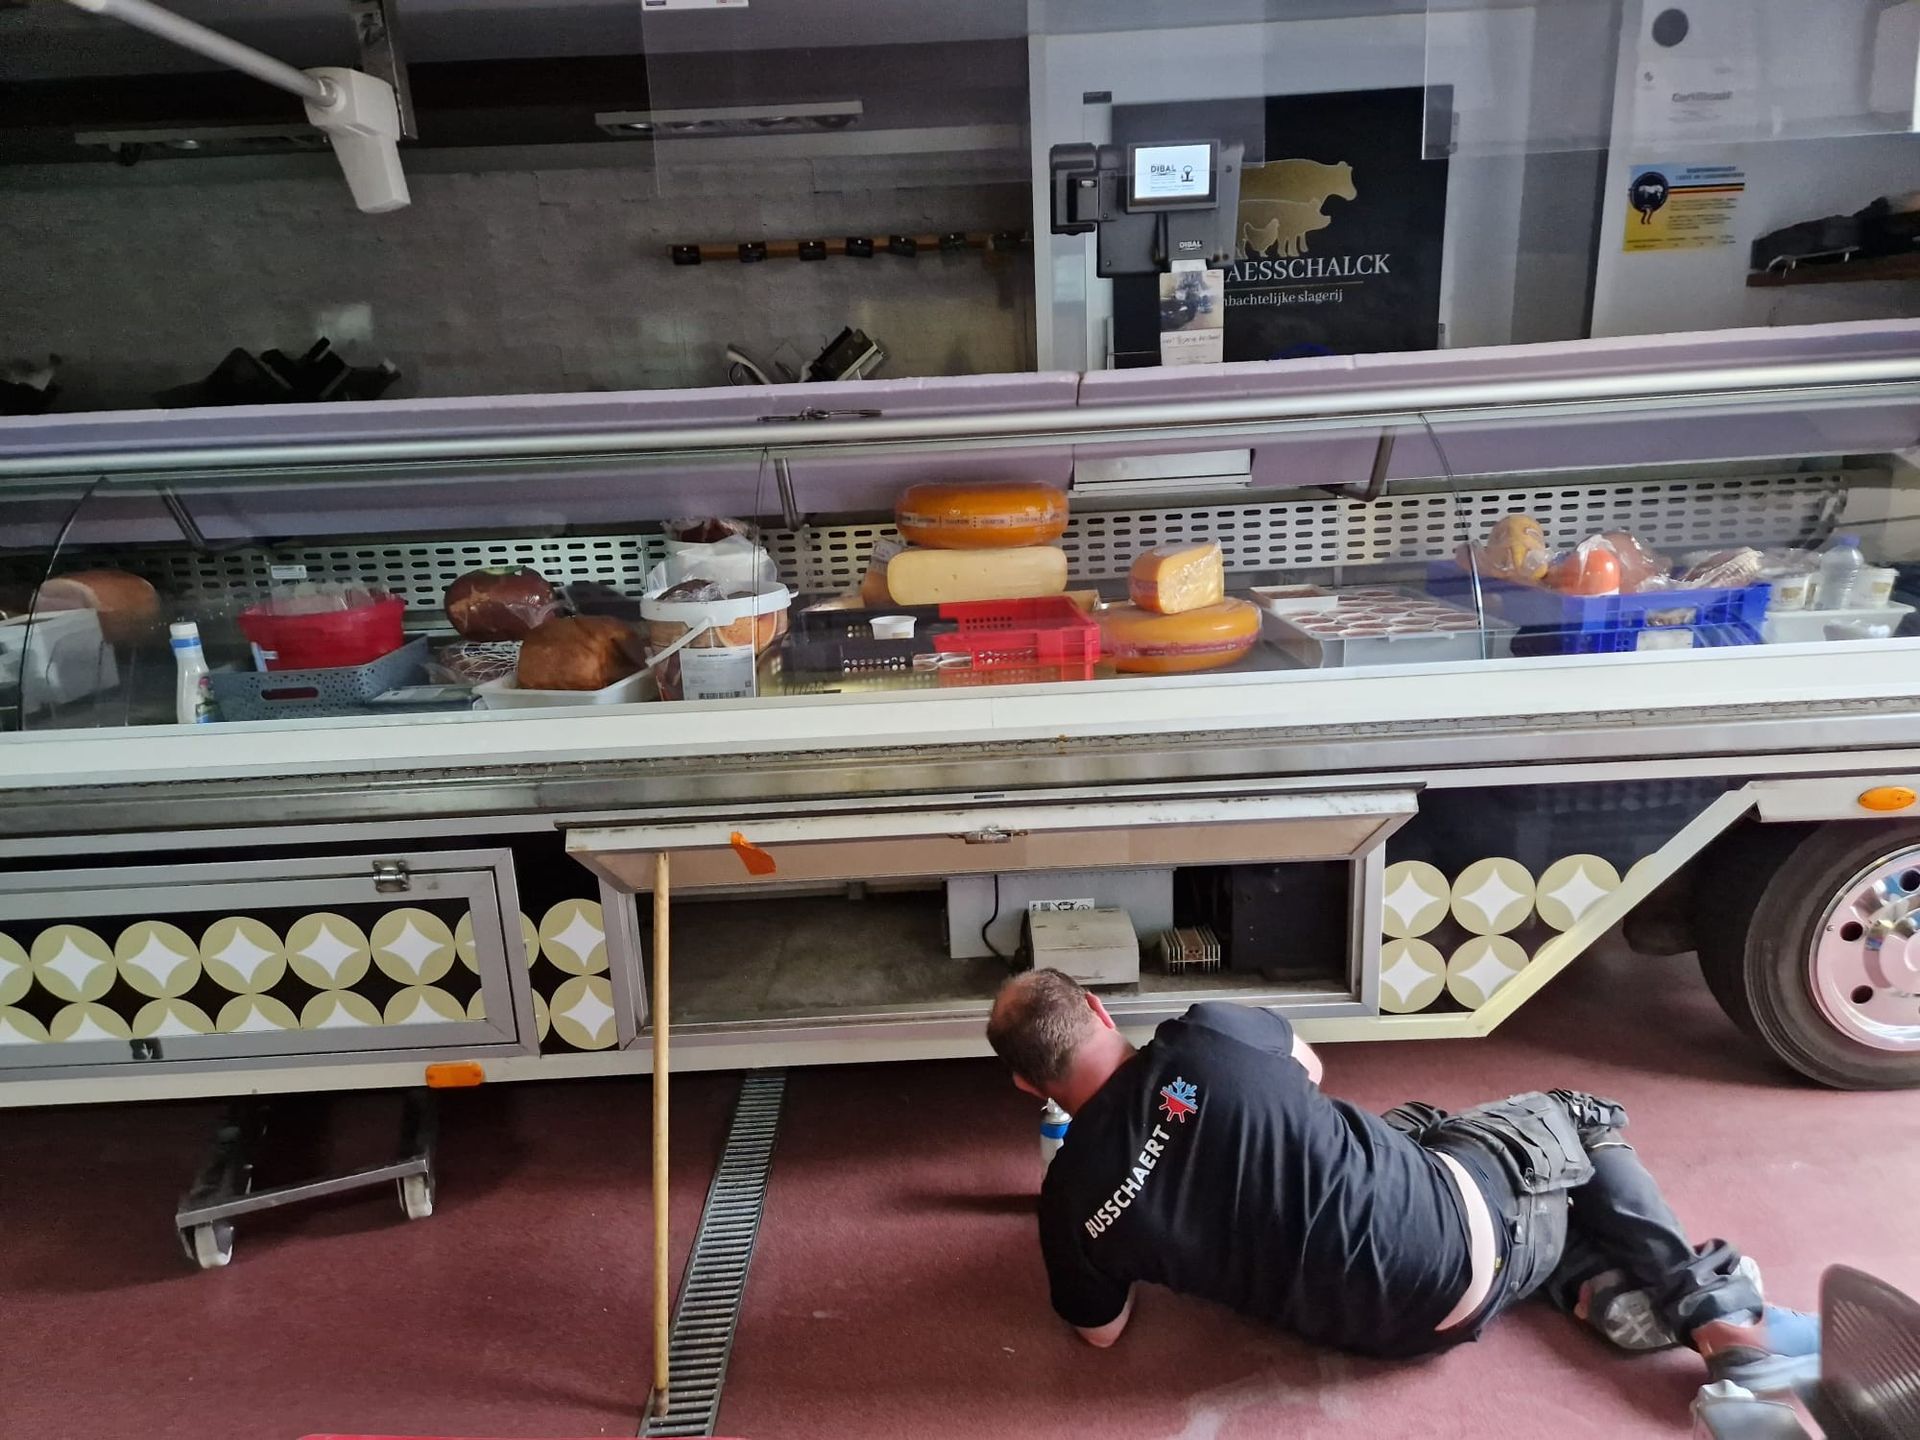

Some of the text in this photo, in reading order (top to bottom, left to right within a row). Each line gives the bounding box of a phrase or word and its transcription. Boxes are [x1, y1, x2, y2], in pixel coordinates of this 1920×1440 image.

[1151, 164, 1176, 172] DIBAL
[1225, 254, 1391, 282] AESSCHALCK
[1297, 288, 1344, 305] slagerij
[1085, 1124, 1170, 1239] BUSSCHAERT
